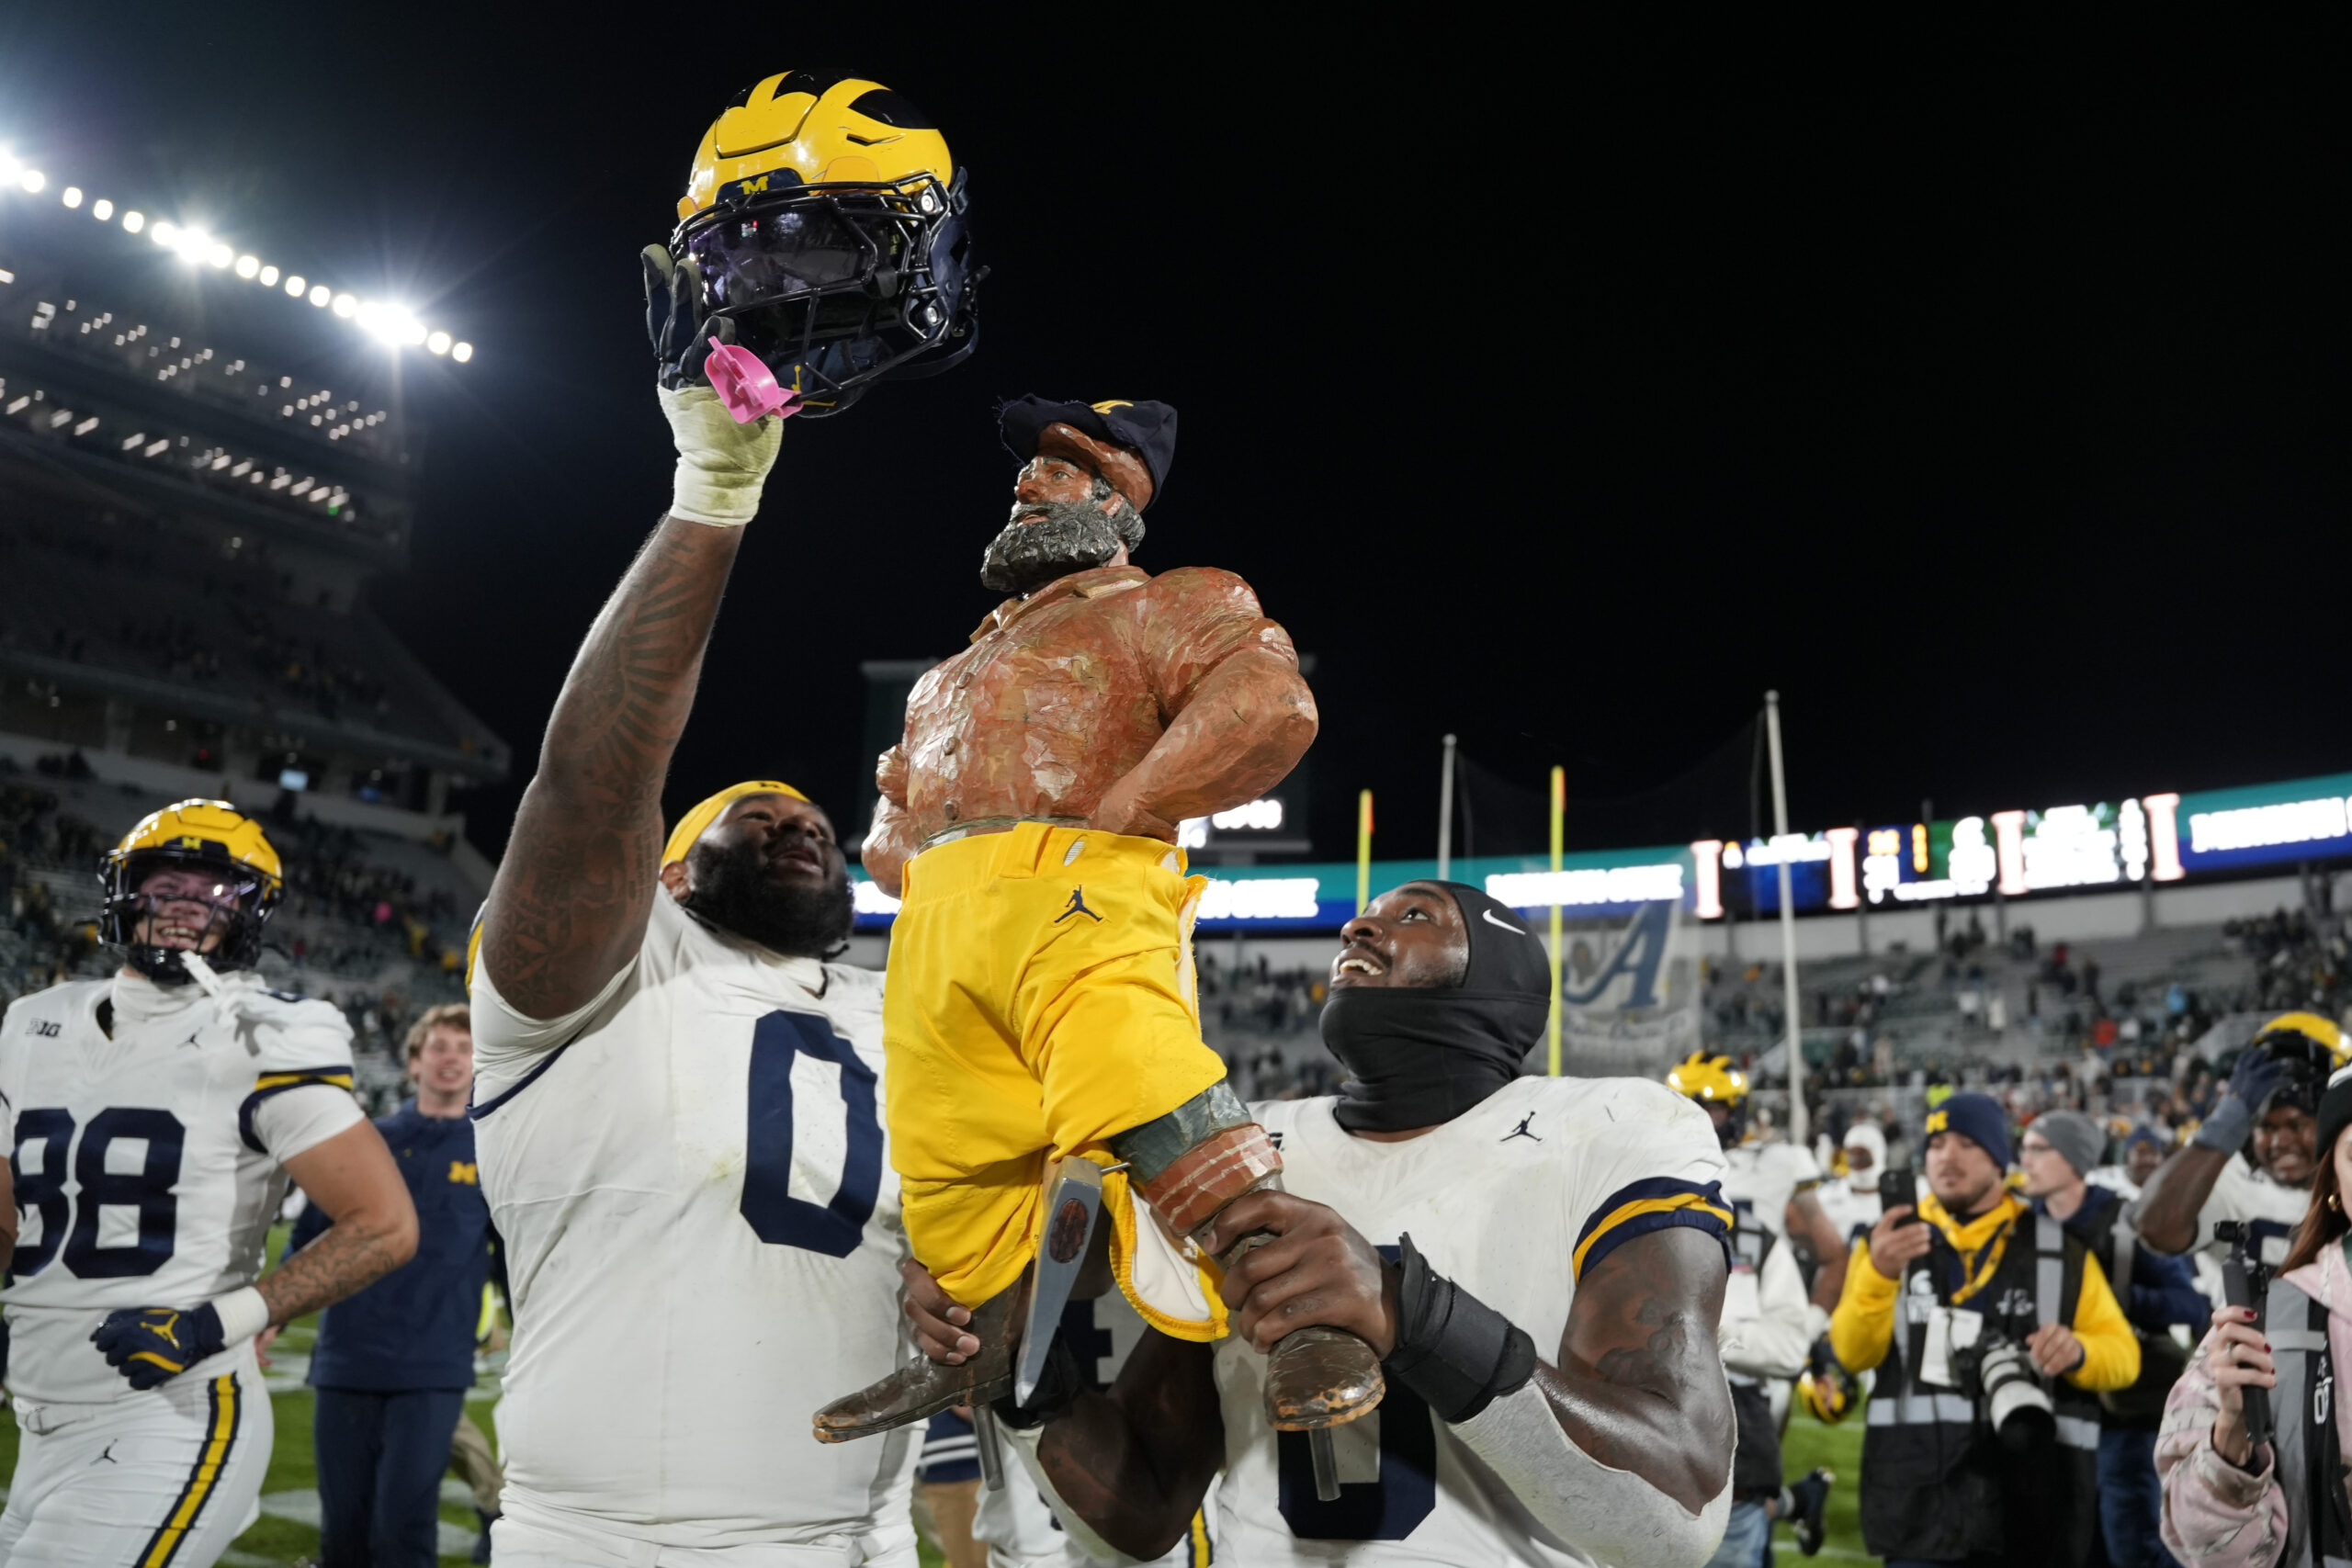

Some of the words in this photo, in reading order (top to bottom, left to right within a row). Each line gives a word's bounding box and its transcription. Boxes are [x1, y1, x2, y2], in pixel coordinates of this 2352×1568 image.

[741, 175, 769, 195] M
[9, 1107, 186, 1279] 88
[740, 1009, 884, 1258] 0
